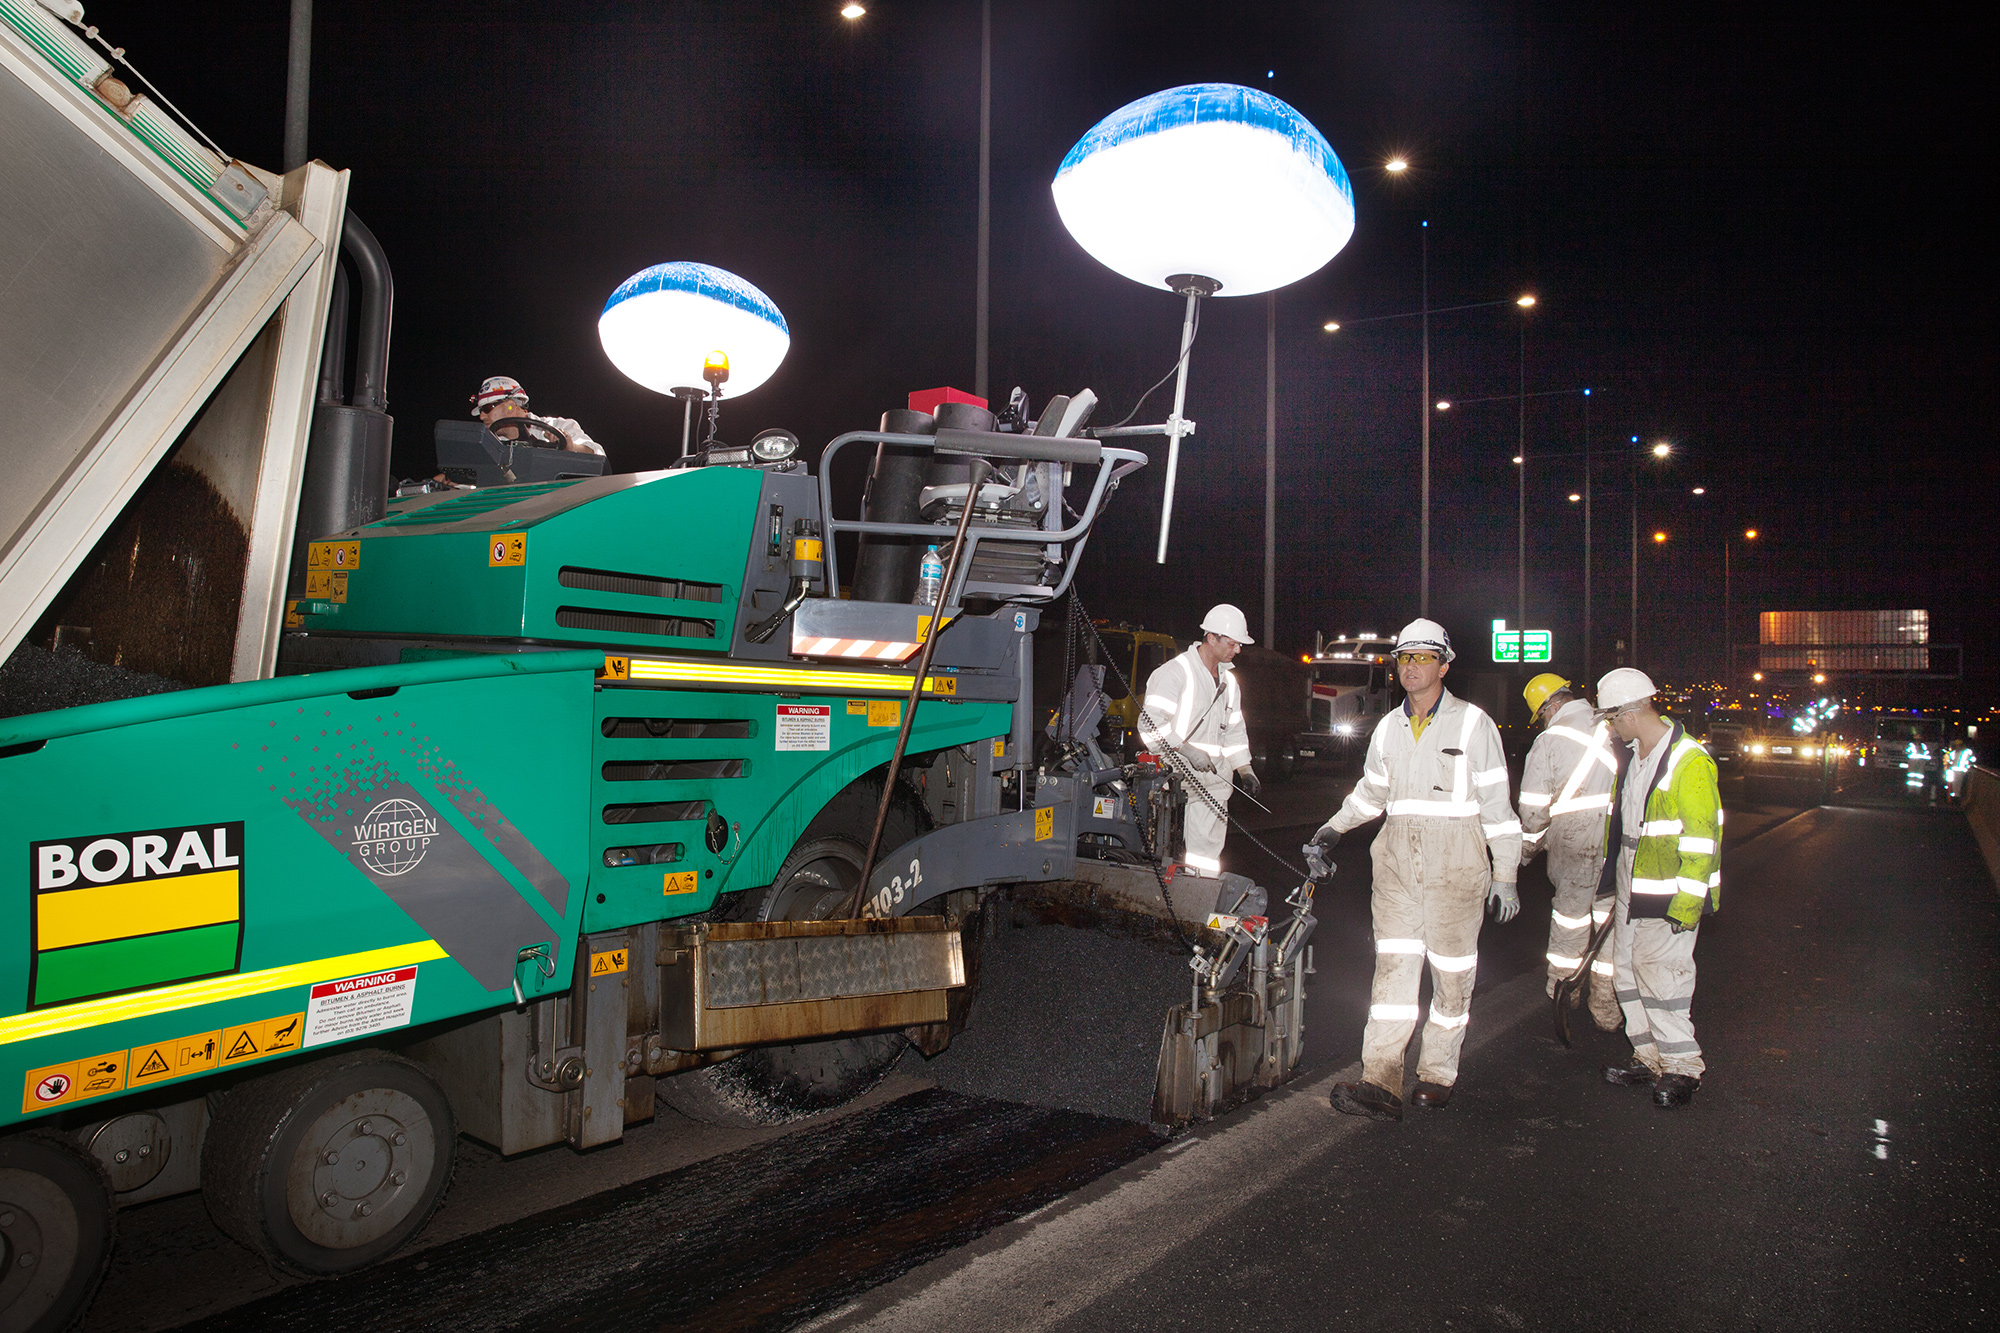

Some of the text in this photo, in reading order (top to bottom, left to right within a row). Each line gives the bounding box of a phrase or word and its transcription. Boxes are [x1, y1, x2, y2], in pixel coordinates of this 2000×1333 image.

[354, 818, 436, 841] WIRTGEN
[38, 828, 239, 889] BORAL
[359, 838, 431, 857] GROUP
[335, 973, 396, 993] WARNING
[320, 995, 349, 1006] BITUMEN
[356, 988, 384, 998] ASPHALT
[385, 984, 406, 993] BURNS
